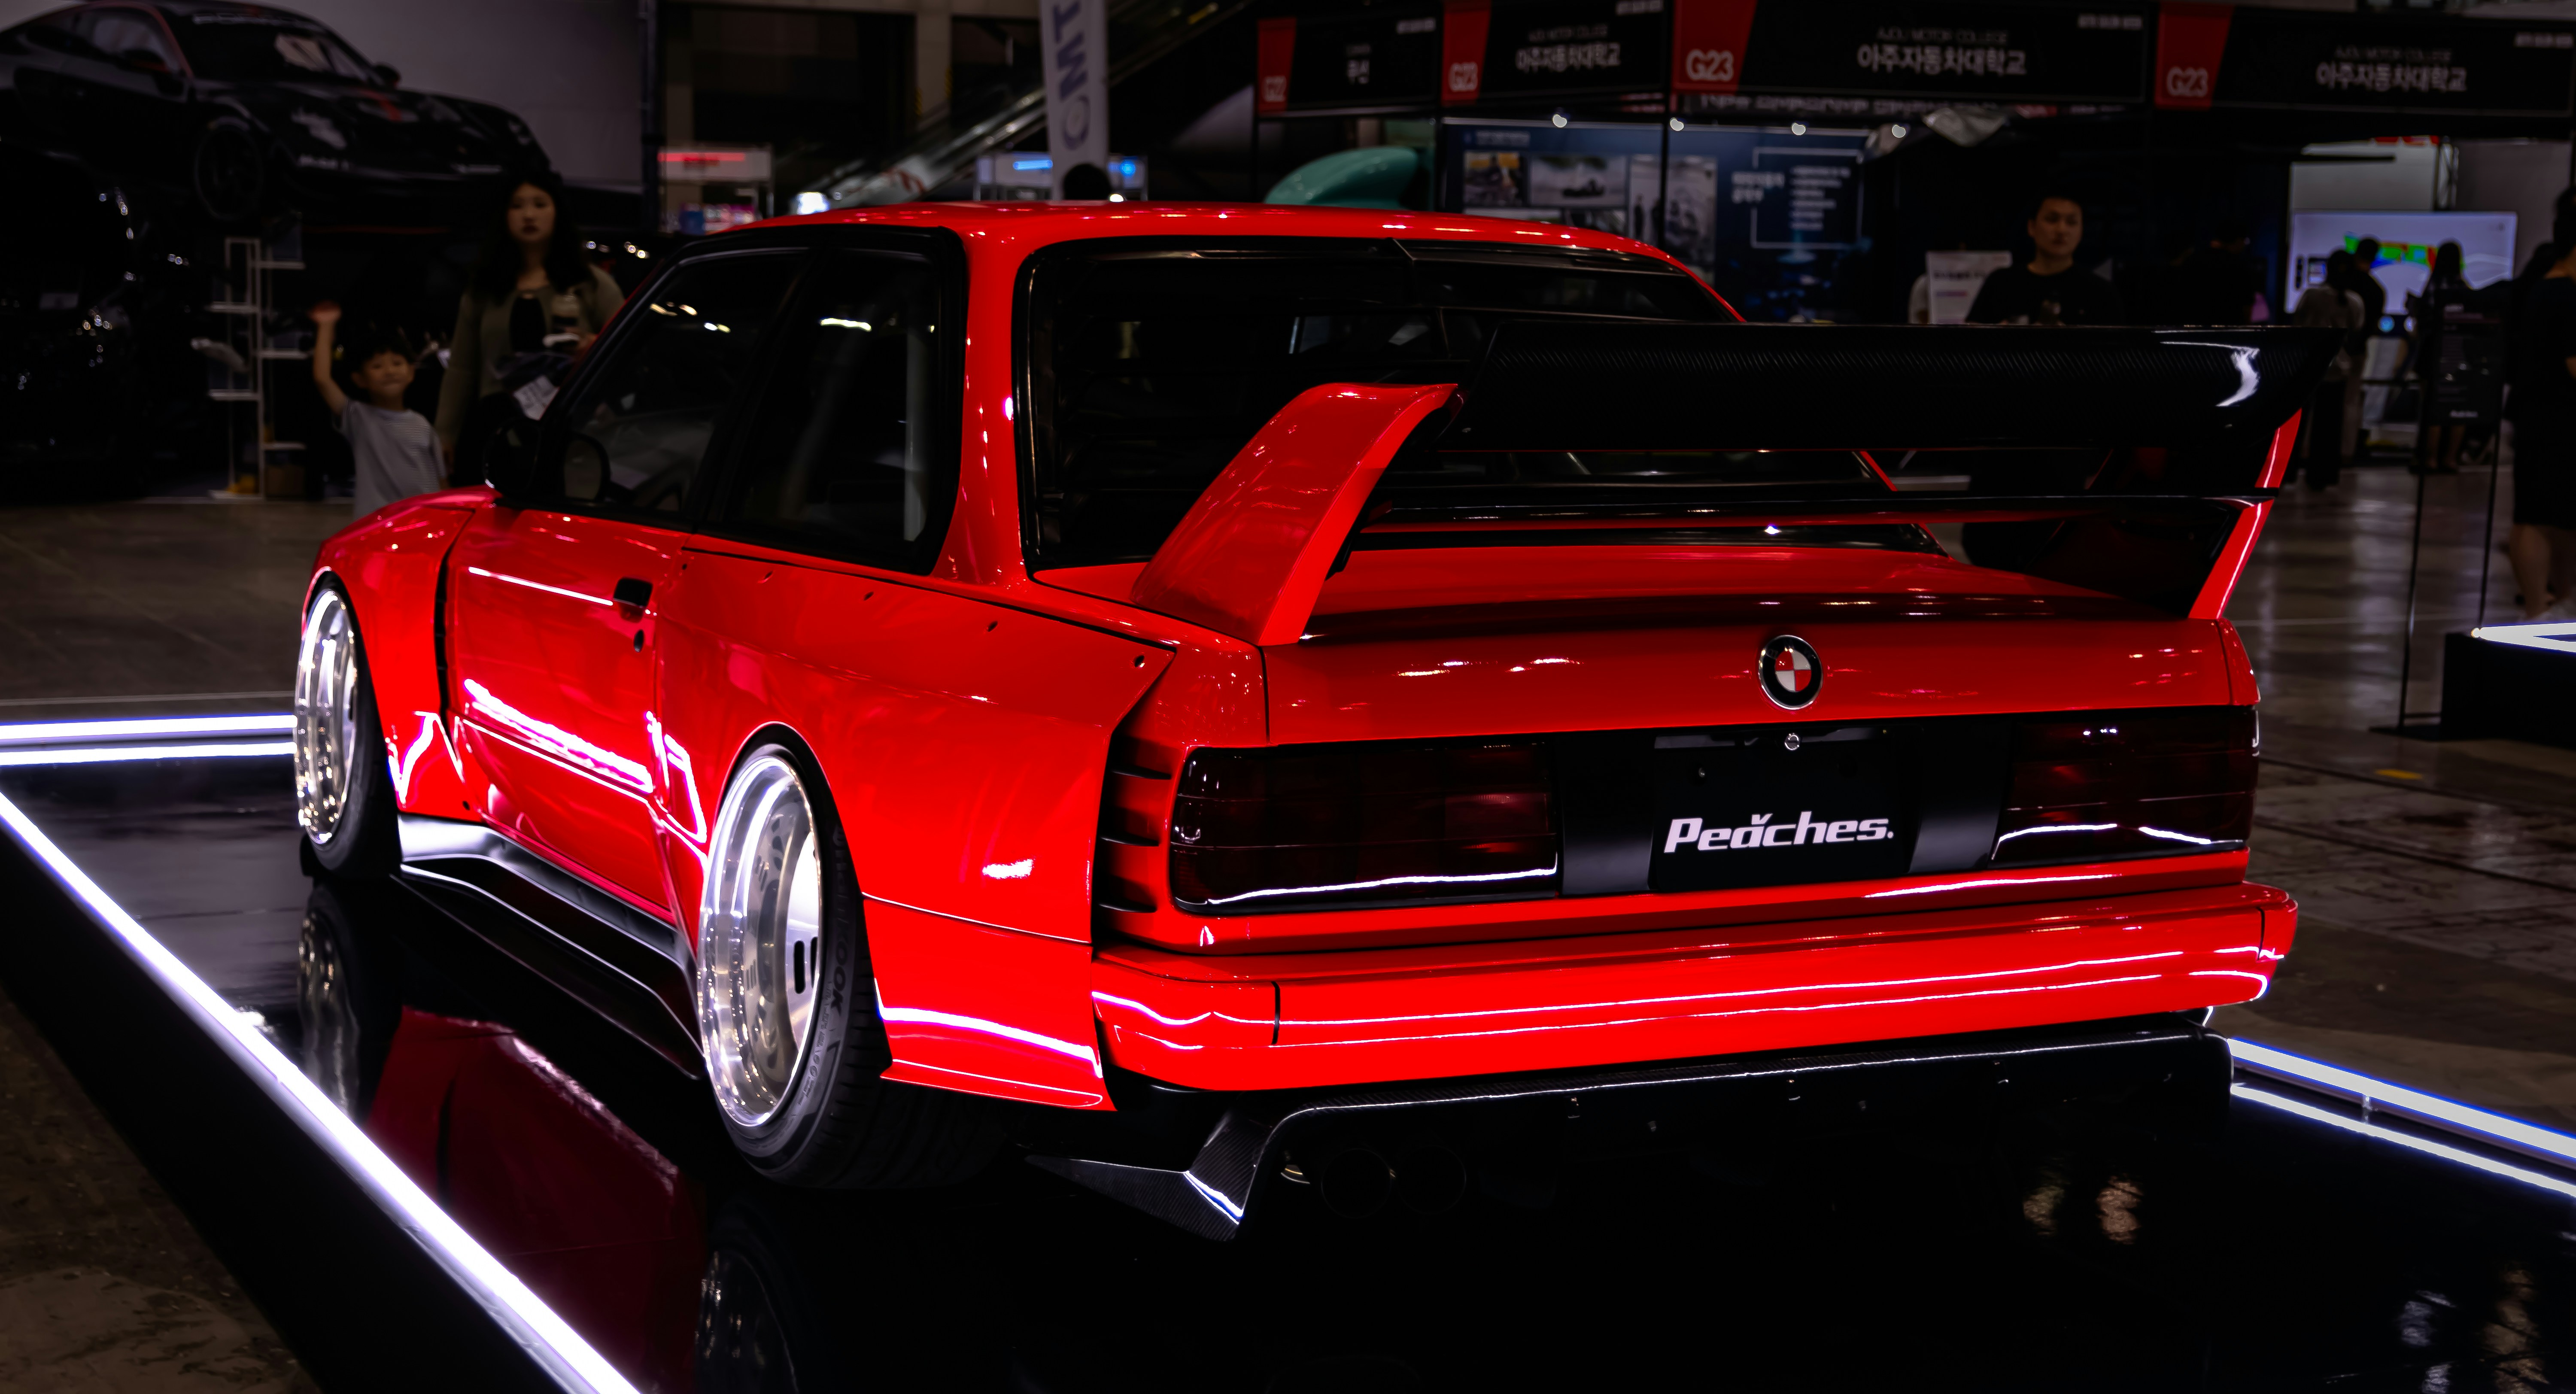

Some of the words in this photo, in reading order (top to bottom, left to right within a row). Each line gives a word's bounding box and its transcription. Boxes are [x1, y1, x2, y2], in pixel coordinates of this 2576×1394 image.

[1685, 48, 1735, 82] G23
[1856, 43, 2027, 78] 아주자동차대학교
[2166, 65, 2210, 98] G23
